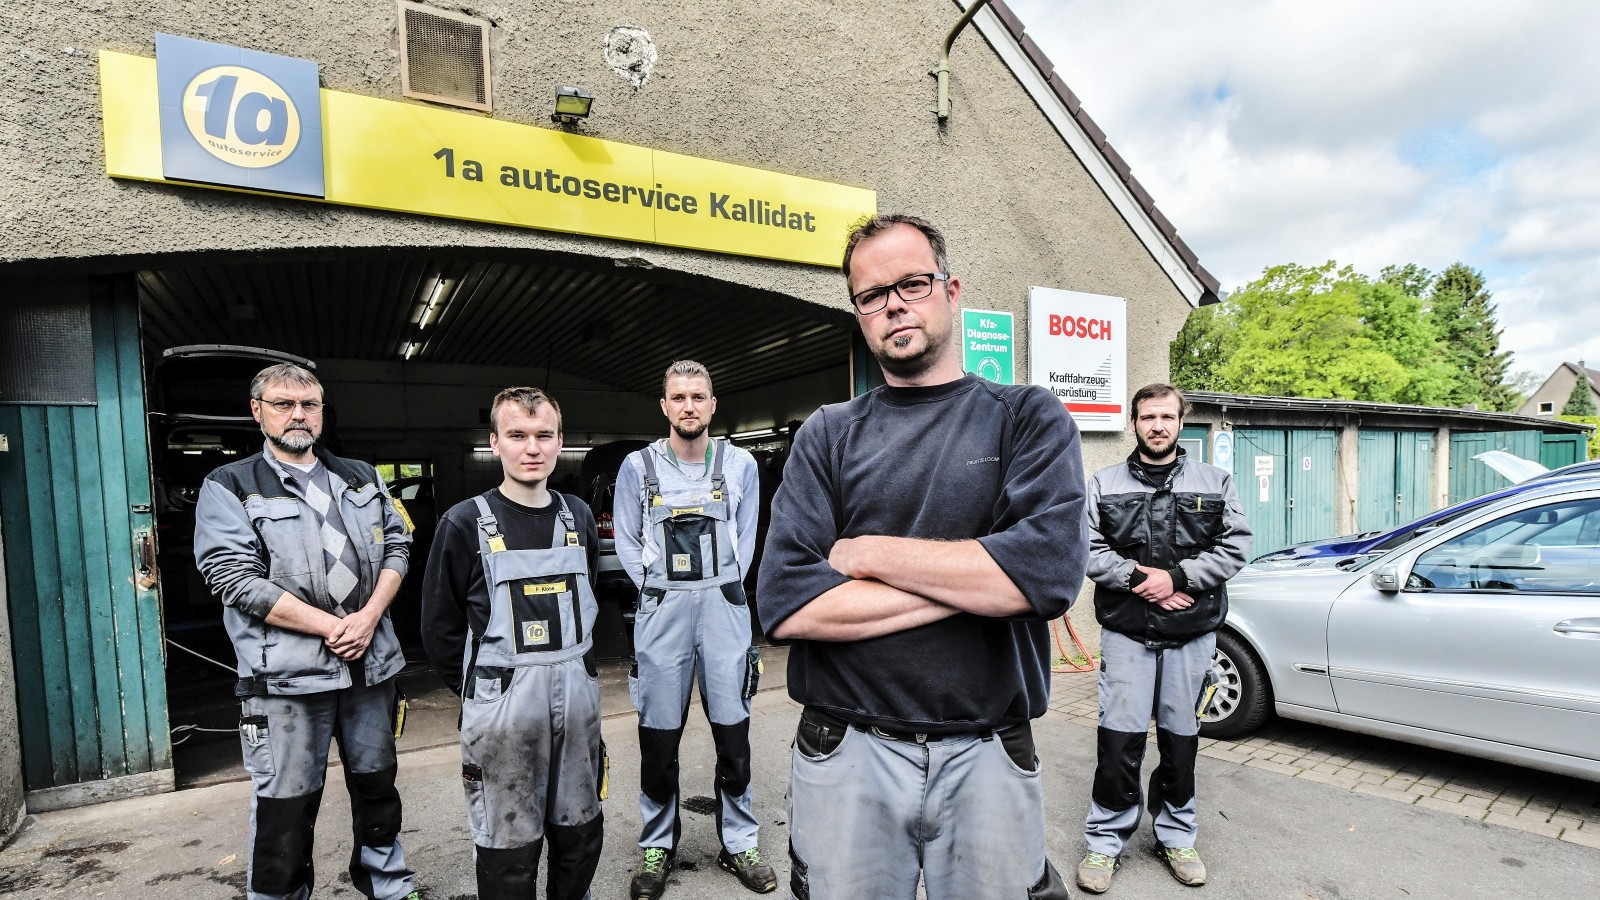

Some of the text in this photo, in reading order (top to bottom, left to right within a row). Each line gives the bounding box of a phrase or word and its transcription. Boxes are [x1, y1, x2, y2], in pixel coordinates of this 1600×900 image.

[195, 75, 288, 146] 1a
[207, 138, 282, 158] autoservice
[433, 147, 817, 233] 1a autoservice Kallidat
[979, 318, 998, 329] Kfz-
[1049, 313, 1112, 341] BOSCH
[967, 328, 1011, 341] Diagnose-
[970, 341, 1008, 353] Zentrum
[1049, 371, 1109, 387] Kraftfahrzeug-
[1050, 385, 1097, 401] Ausrüstung
